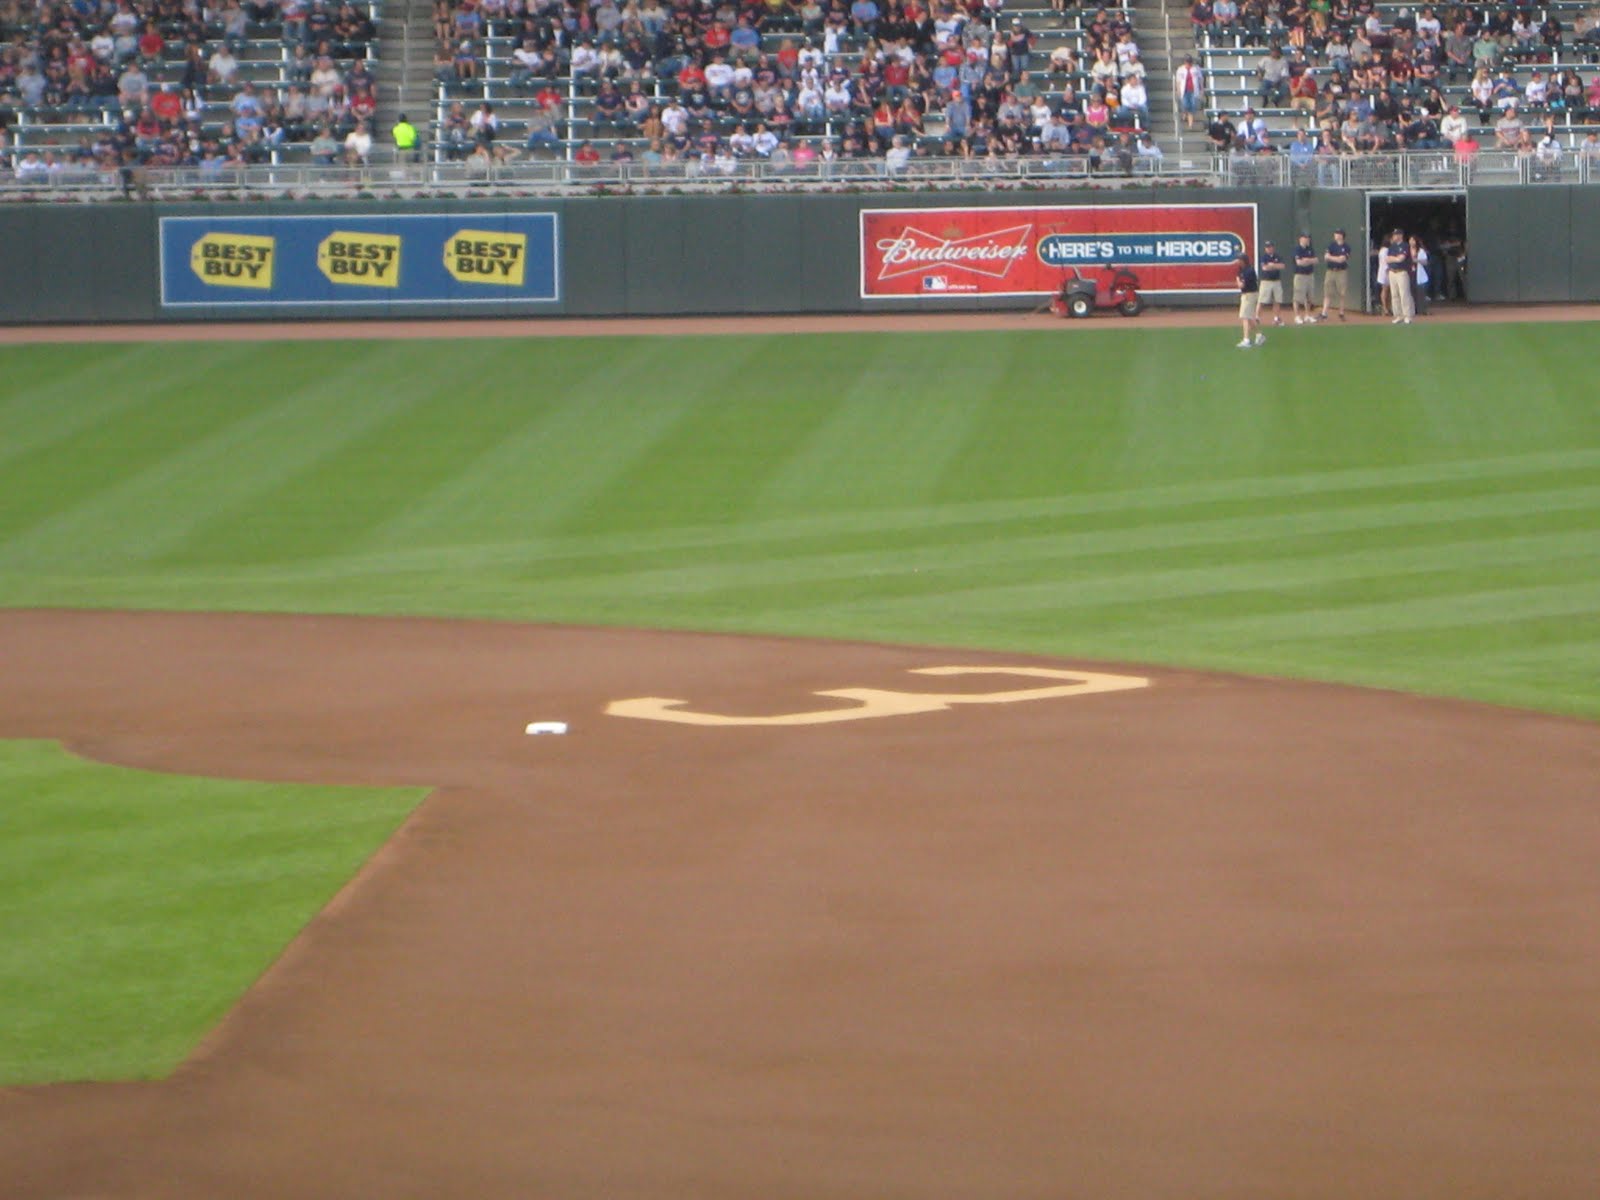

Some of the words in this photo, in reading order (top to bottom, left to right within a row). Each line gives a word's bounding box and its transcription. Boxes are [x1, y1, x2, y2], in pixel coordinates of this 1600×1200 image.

[202, 243, 271, 262] BEST
[329, 241, 397, 261] BEST
[455, 239, 522, 260] BEST
[876, 238, 1029, 264] Budweiser
[1049, 241, 1115, 259] HERE'S
[1117, 245, 1132, 255] TO
[1134, 245, 1154, 255] THE
[1156, 240, 1233, 257] HEROES
[204, 260, 264, 279] BUY
[331, 258, 391, 278] BUY
[456, 257, 516, 276] BUY
